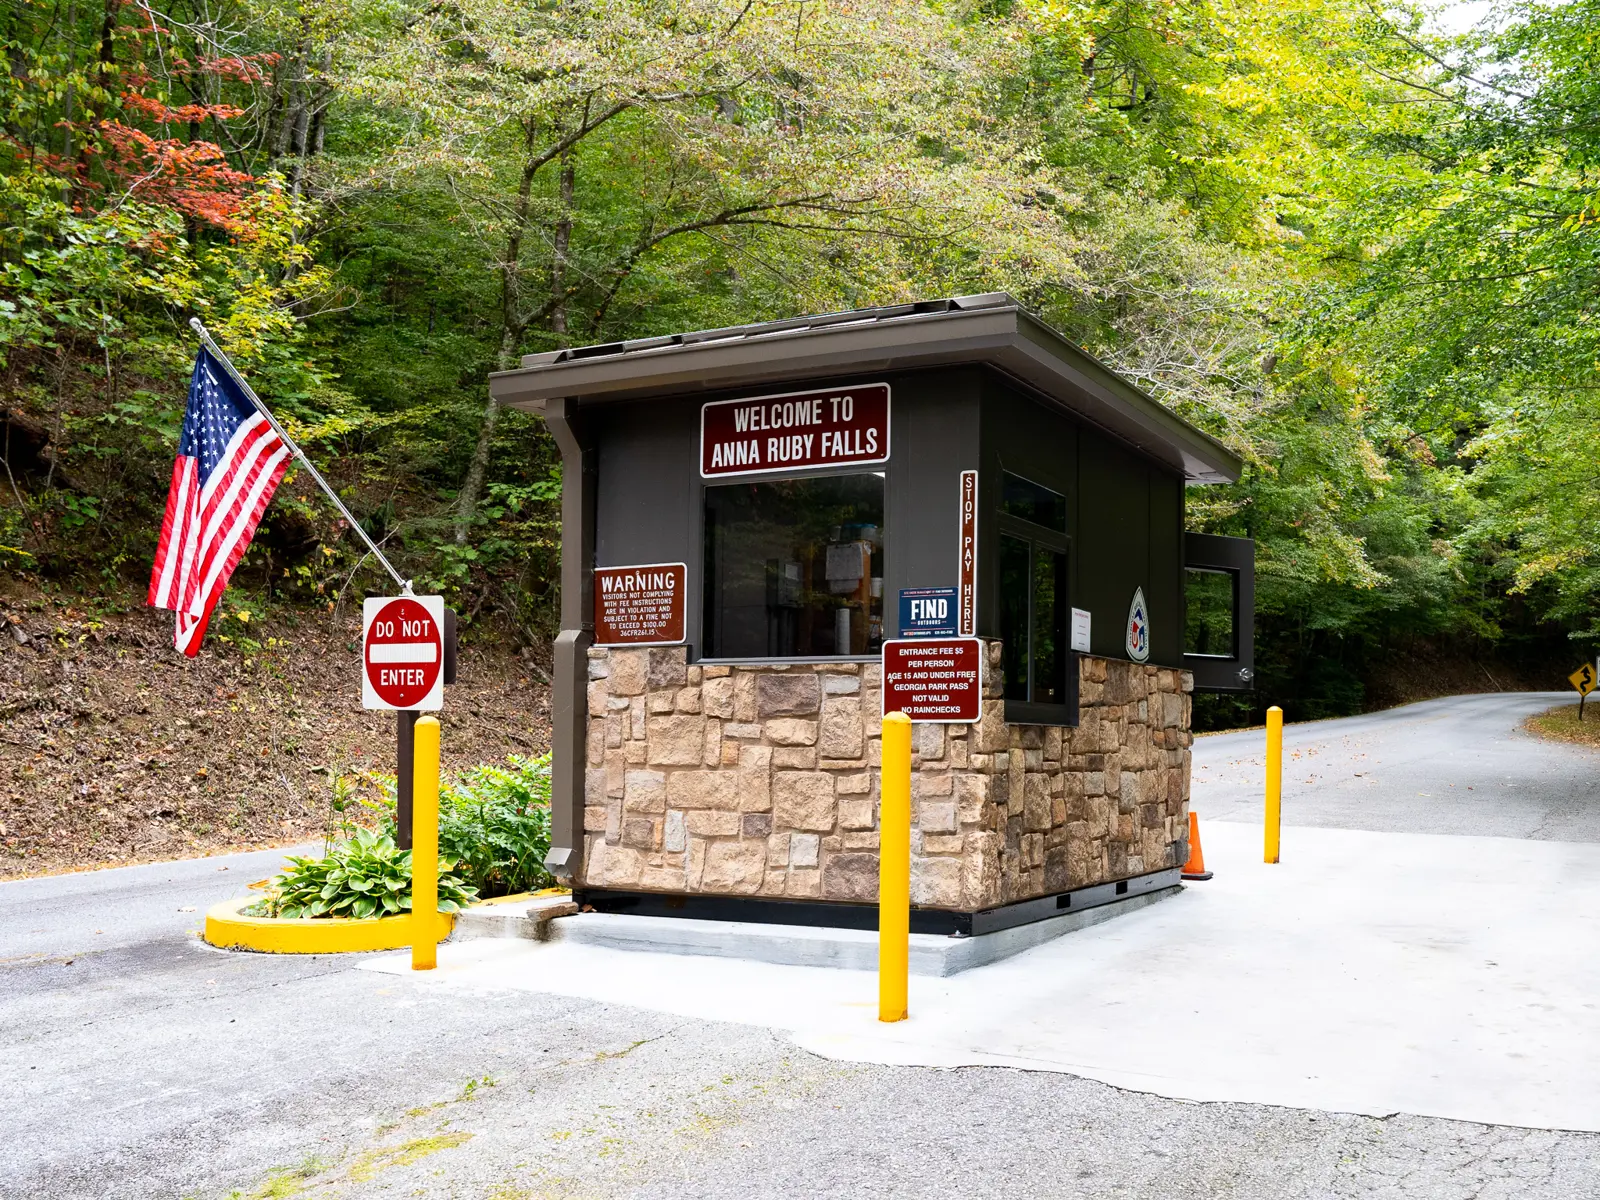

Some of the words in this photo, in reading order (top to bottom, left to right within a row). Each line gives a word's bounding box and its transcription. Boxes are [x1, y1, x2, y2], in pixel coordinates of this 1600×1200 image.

[734, 400, 823, 432] WELCOME
[830, 396, 853, 422] TO
[712, 440, 760, 467] ANNA
[768, 434, 814, 462] RUBY
[821, 428, 878, 457] FALLS
[965, 477, 973, 524] STOP
[964, 537, 972, 571] PAY
[602, 572, 675, 592] WARNING
[911, 599, 947, 620] FIND
[377, 621, 394, 638] DO
[403, 620, 430, 637] NOT
[899, 648, 937, 656] ENTRANCE
[381, 669, 424, 686] ENTER
[930, 671, 955, 679] UNDER
